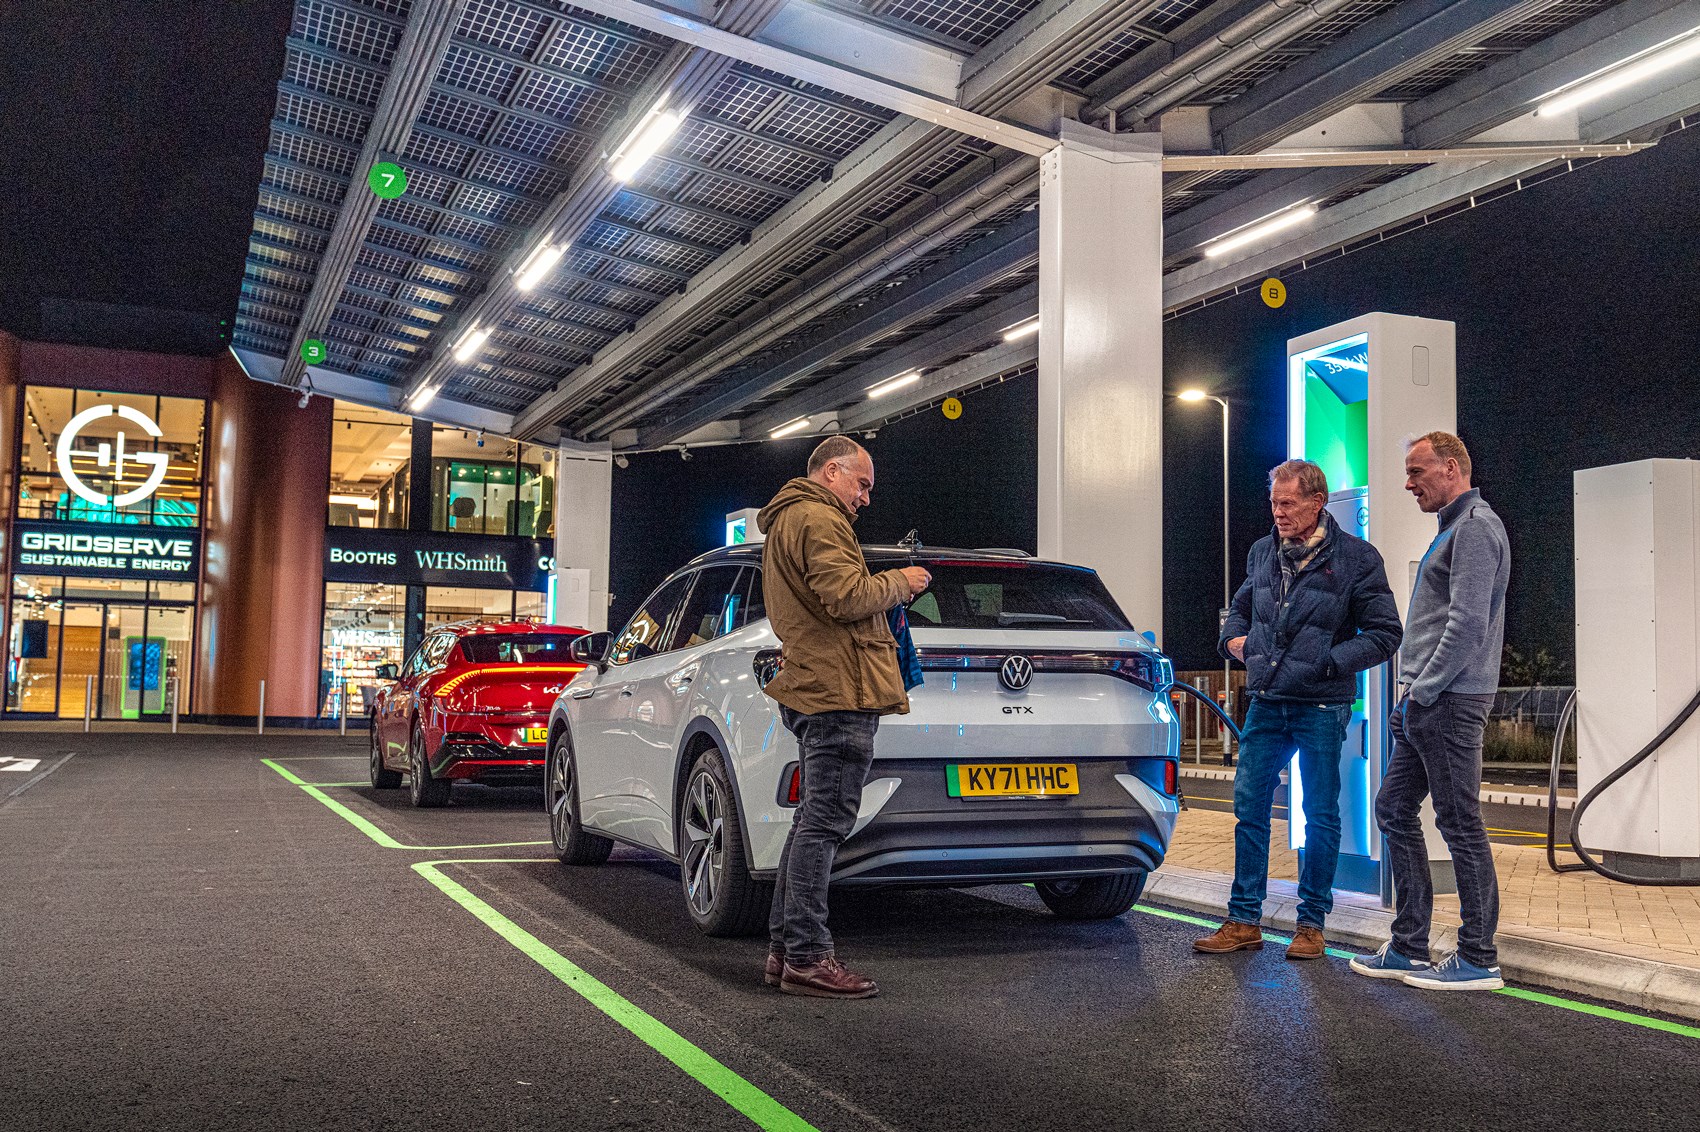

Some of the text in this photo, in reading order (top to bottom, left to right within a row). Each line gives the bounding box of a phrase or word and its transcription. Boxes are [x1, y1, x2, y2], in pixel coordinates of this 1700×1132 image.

[381, 173, 395, 187] 7
[1269, 288, 1278, 298] 8
[308, 346, 319, 357] 3
[948, 404, 955, 412] 4
[21, 531, 193, 557] GRIDSERVE
[20, 553, 192, 572] SUSTAINABLE ENERGY
[330, 548, 397, 566] BOOTHS
[415, 550, 507, 573] WHSmith
[1002, 706, 1033, 714] GTX
[968, 767, 1070, 791] KY71 HHC
